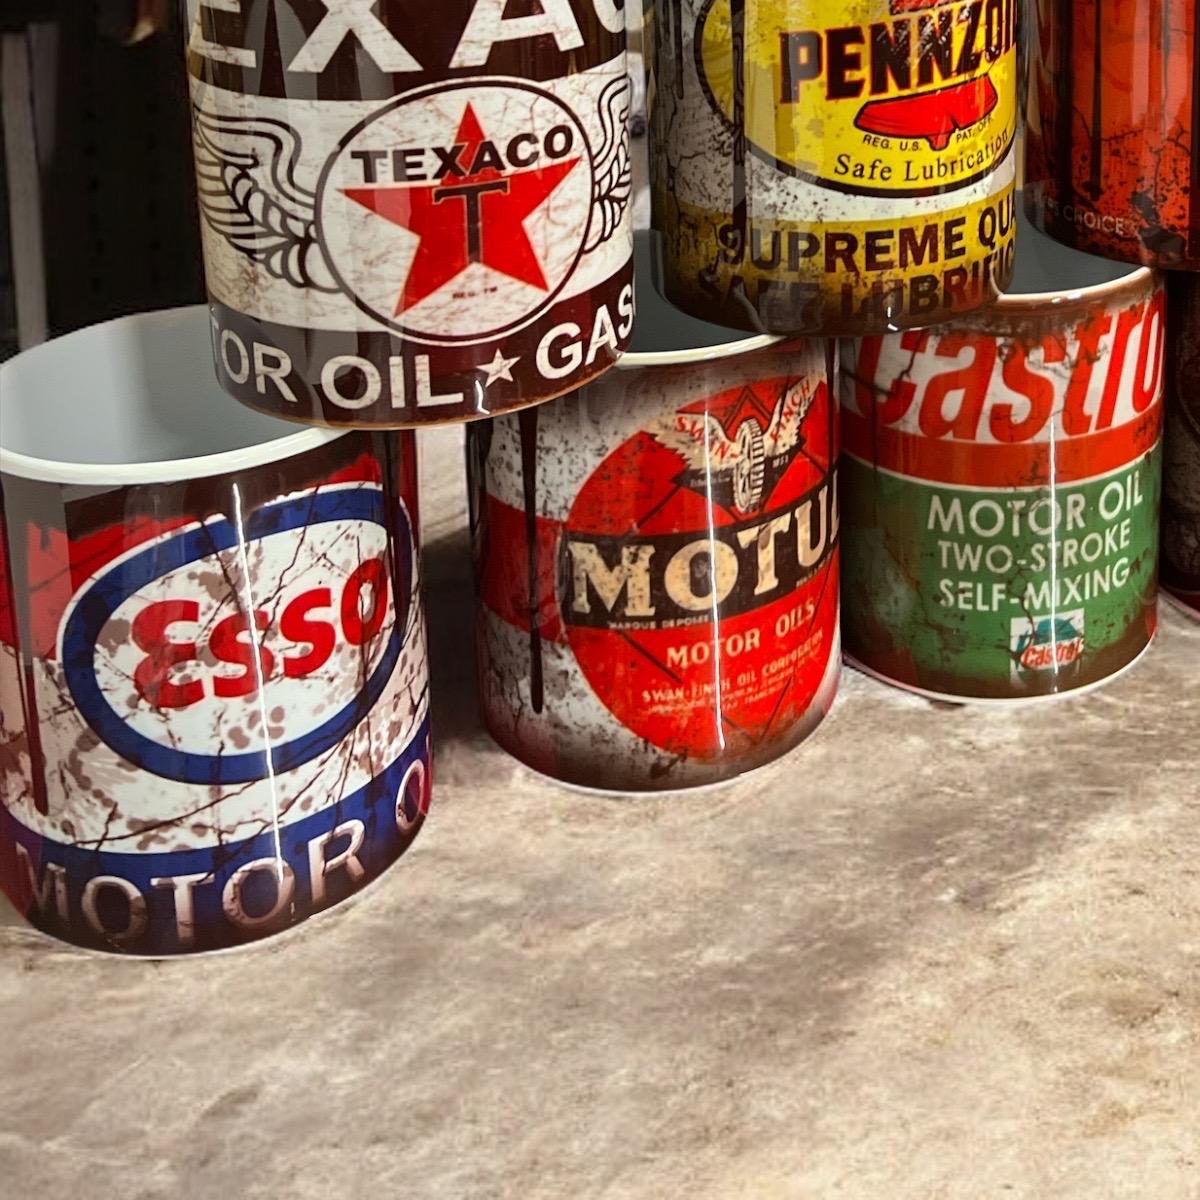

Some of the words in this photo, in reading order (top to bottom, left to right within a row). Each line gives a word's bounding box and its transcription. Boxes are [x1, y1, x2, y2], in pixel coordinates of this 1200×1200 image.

[350, 124, 575, 184] TEXACO
[834, 153, 893, 181] Safe
[903, 127, 1009, 182] Lubrication
[862, 133, 894, 150] REG.
[718, 215, 967, 274] SUPREME
[320, 352, 464, 412] OIL
[927, 494, 1087, 538] MOTOR
[1098, 470, 1144, 522] OIL
[937, 518, 1131, 574] TWO-STROKE
[938, 556, 1131, 612] SELF-MIXING
[667, 627, 761, 669] MOTOR
[774, 601, 816, 639] OILS
[737, 669, 757, 687] OIL
[14, 818, 367, 945] MOTOR
